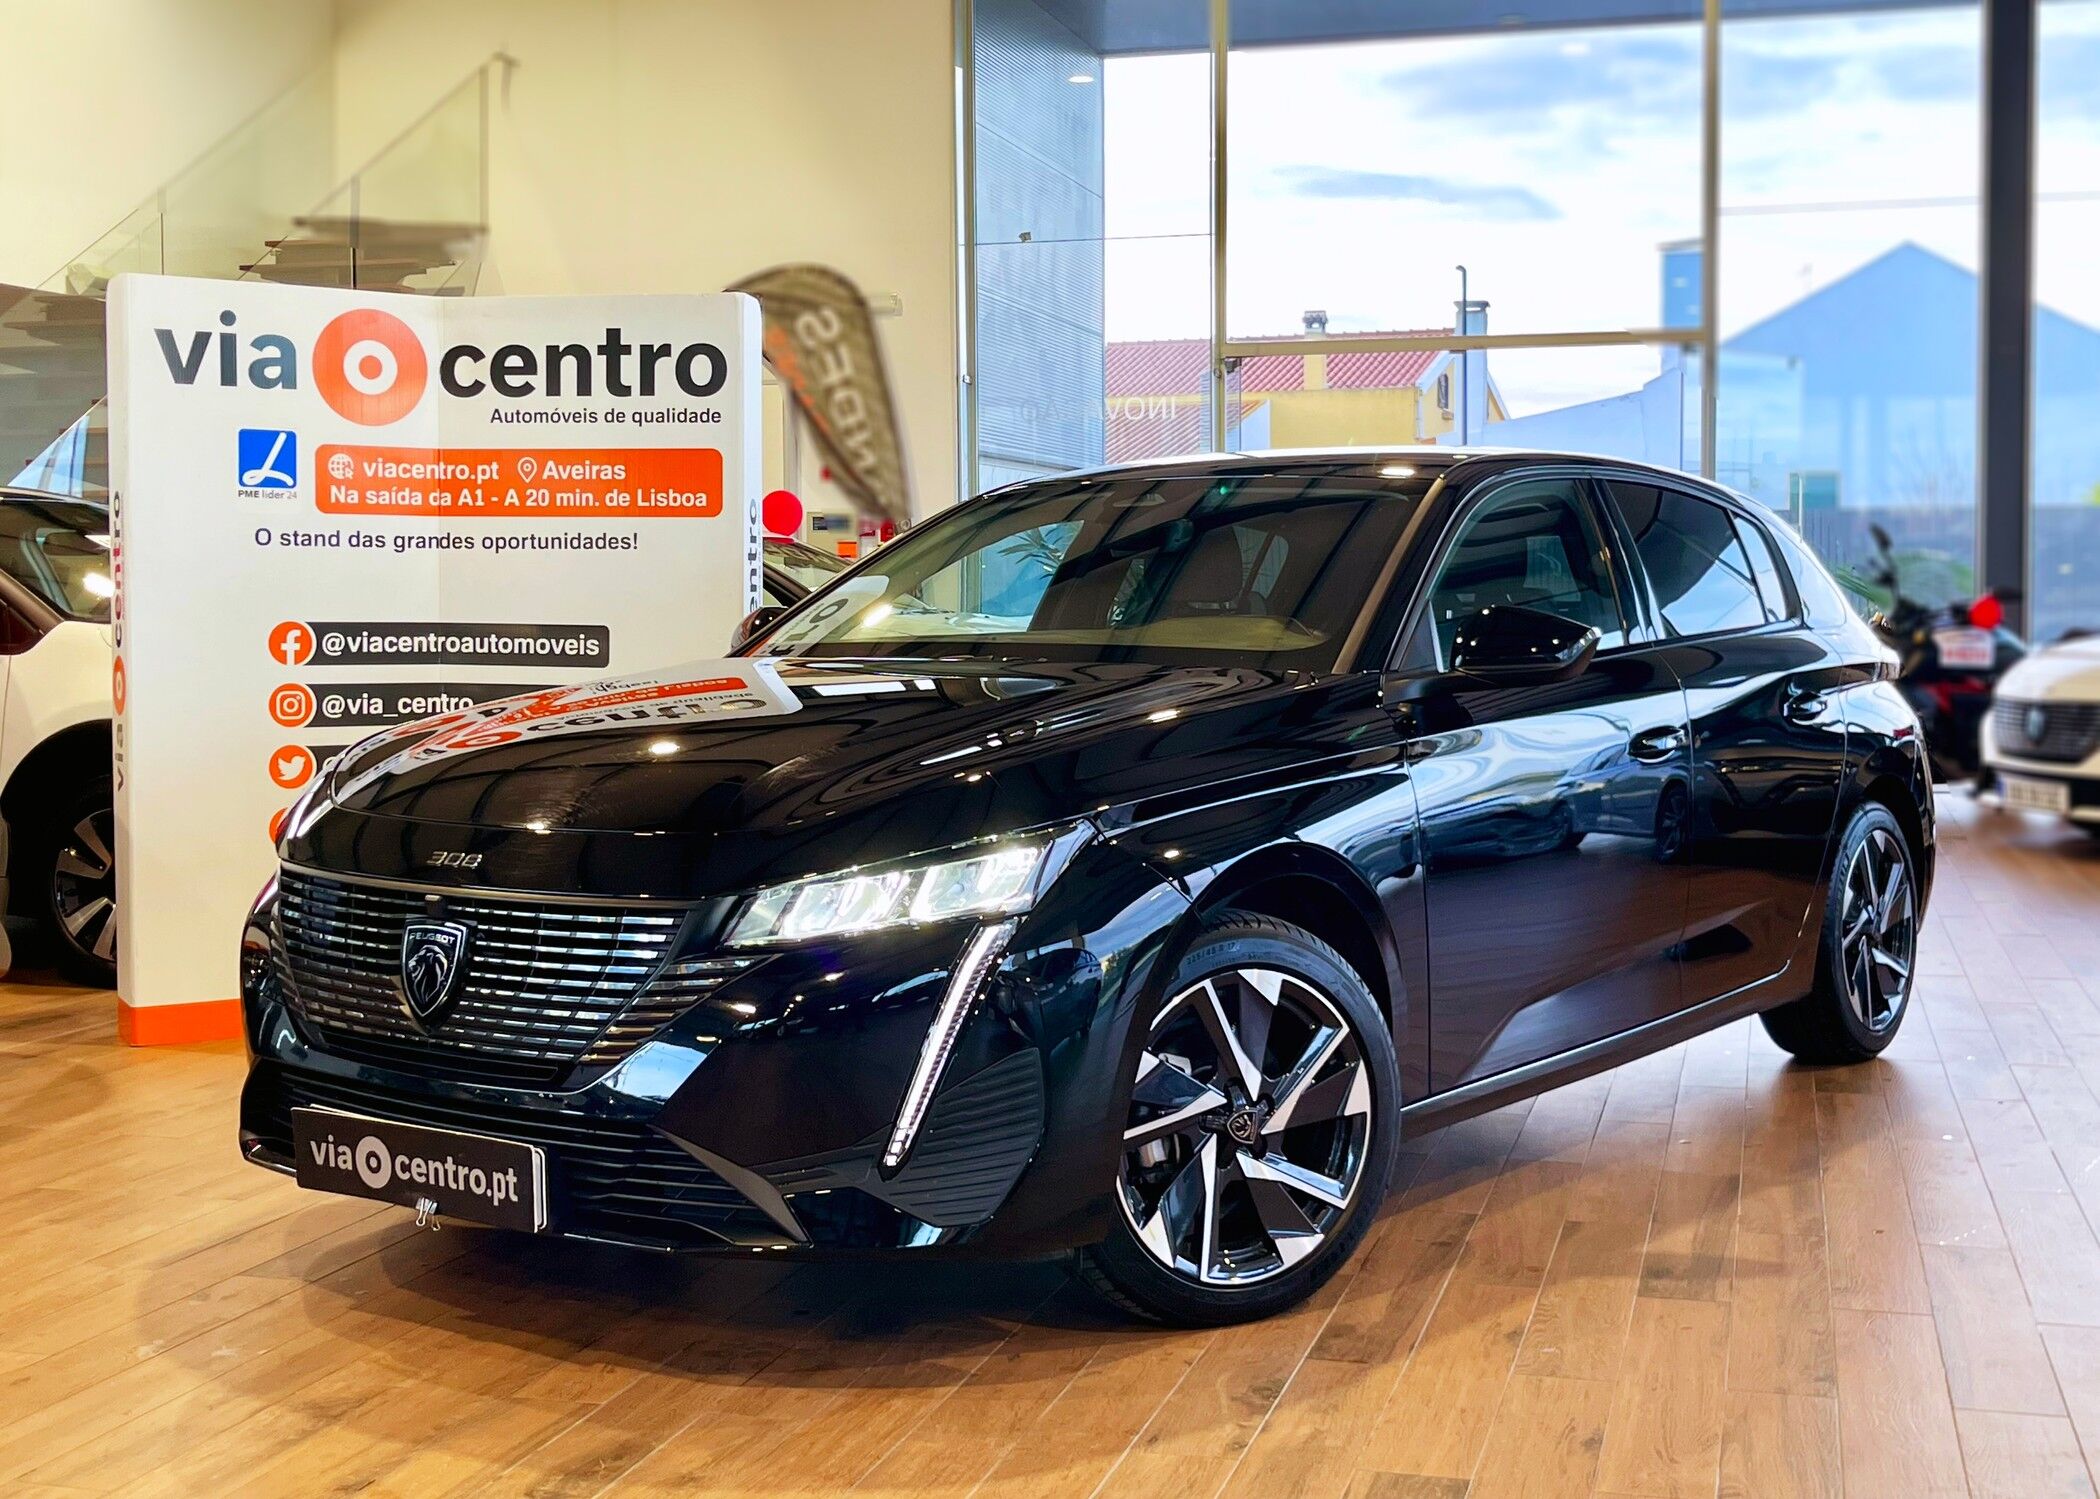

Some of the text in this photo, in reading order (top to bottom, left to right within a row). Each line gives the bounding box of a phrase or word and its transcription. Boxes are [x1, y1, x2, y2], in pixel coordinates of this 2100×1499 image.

[153, 309, 297, 390] via
[439, 327, 728, 398] centro
[490, 407, 721, 427] Automóveis de qualidade
[363, 457, 627, 484] viacentro.pt Aveiras
[237, 489, 260, 498] PME
[330, 485, 359, 505] Na
[365, 485, 422, 505] saída
[428, 488, 452, 506] da
[457, 488, 485, 506] A1
[504, 488, 520, 507] A
[525, 488, 550, 507] 20
[555, 488, 600, 507] min.
[605, 488, 631, 507] de
[637, 488, 707, 507] Lisboa
[254, 528, 639, 554] O stand das grandes oportunidades!
[748, 498, 758, 612] entro
[321, 631, 600, 657] @viacentroautomoveis
[426, 851, 483, 869] 308
[409, 931, 456, 945] PEUGEOT
[309, 1134, 519, 1206] via centro.pt
